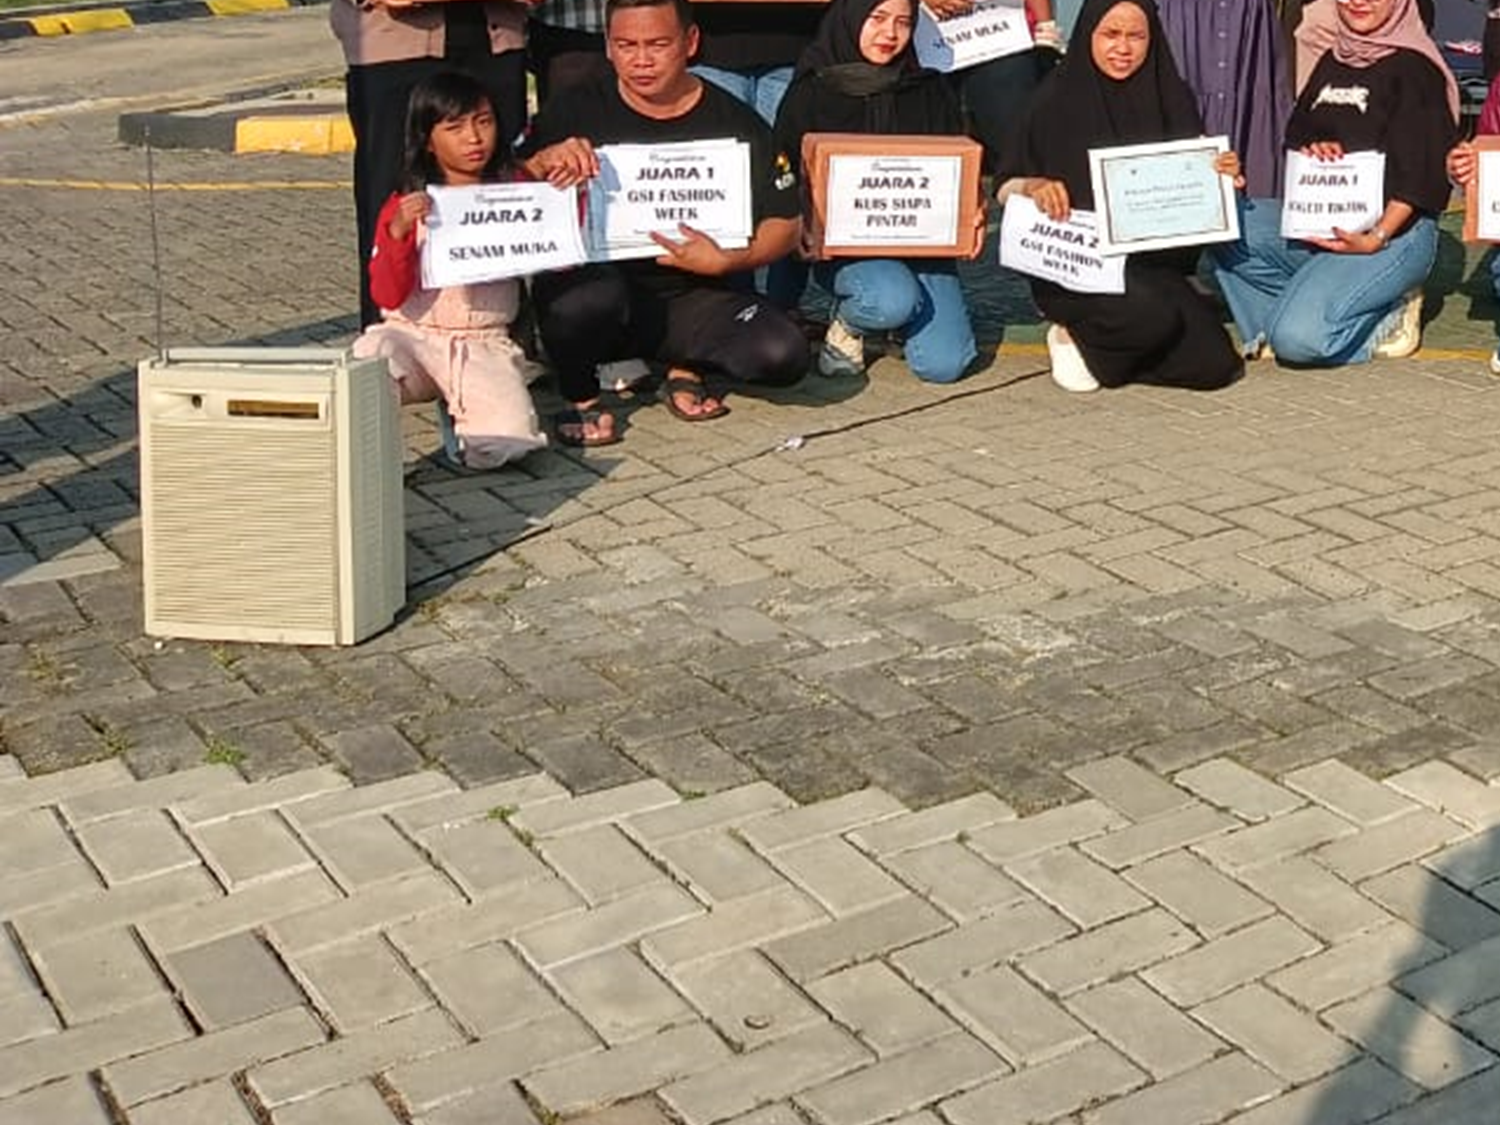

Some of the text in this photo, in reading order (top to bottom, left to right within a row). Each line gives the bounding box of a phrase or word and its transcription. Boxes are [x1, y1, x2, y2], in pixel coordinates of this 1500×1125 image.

[637, 167, 714, 181] JUARA 1
[1298, 173, 1359, 186] JUARA 1
[858, 176, 930, 189] JUARA 2
[627, 189, 726, 204] GSI FASHION
[854, 197, 932, 210] KUIS SIAPA
[459, 208, 543, 225] JUARA 2
[654, 207, 698, 221] WEEK
[866, 214, 918, 227] PINTAR
[1028, 222, 1085, 246] JUARA
[1088, 236, 1100, 248] 2
[449, 241, 558, 262] SENAM MUKA
[1020, 237, 1103, 270] GSI FASHION
[1042, 256, 1080, 277] WEEK
